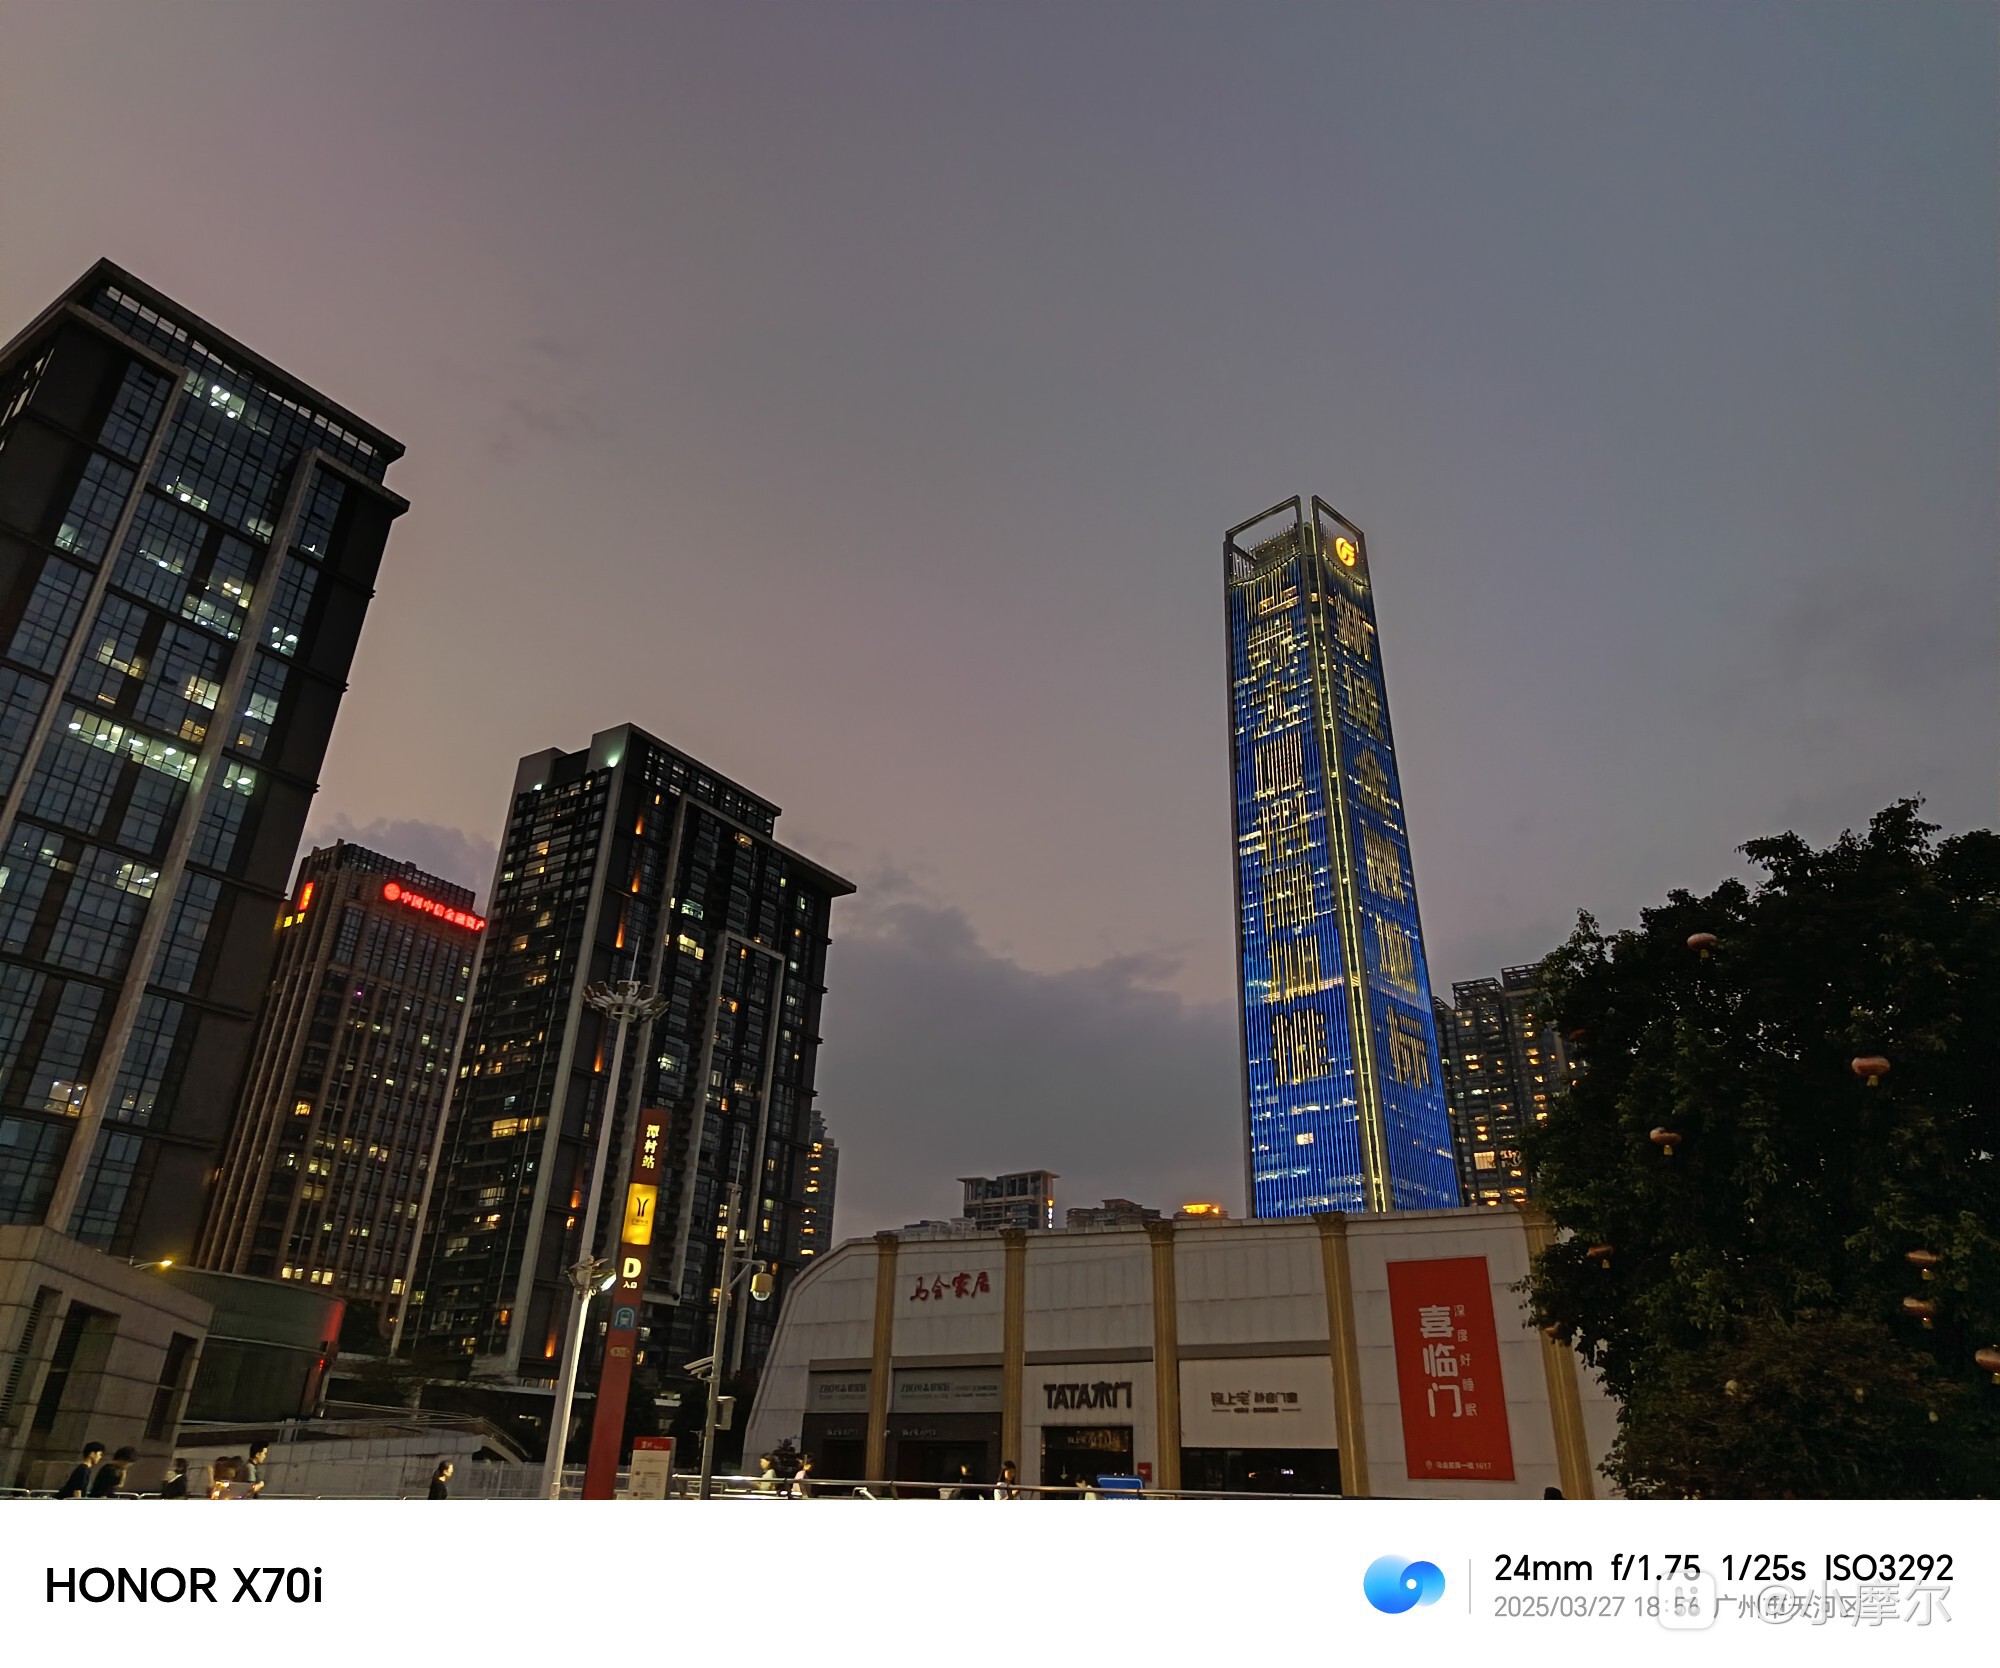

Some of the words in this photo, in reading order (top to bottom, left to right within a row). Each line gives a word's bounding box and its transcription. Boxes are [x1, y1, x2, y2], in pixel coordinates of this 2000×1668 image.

[623, 1257, 642, 1279] D
[623, 1280, 638, 1289] 入口
[910, 1271, 991, 1302] 马会家居
[1419, 1305, 1462, 1417] 喜临门
[1454, 1304, 1478, 1416] 深度好睡眠
